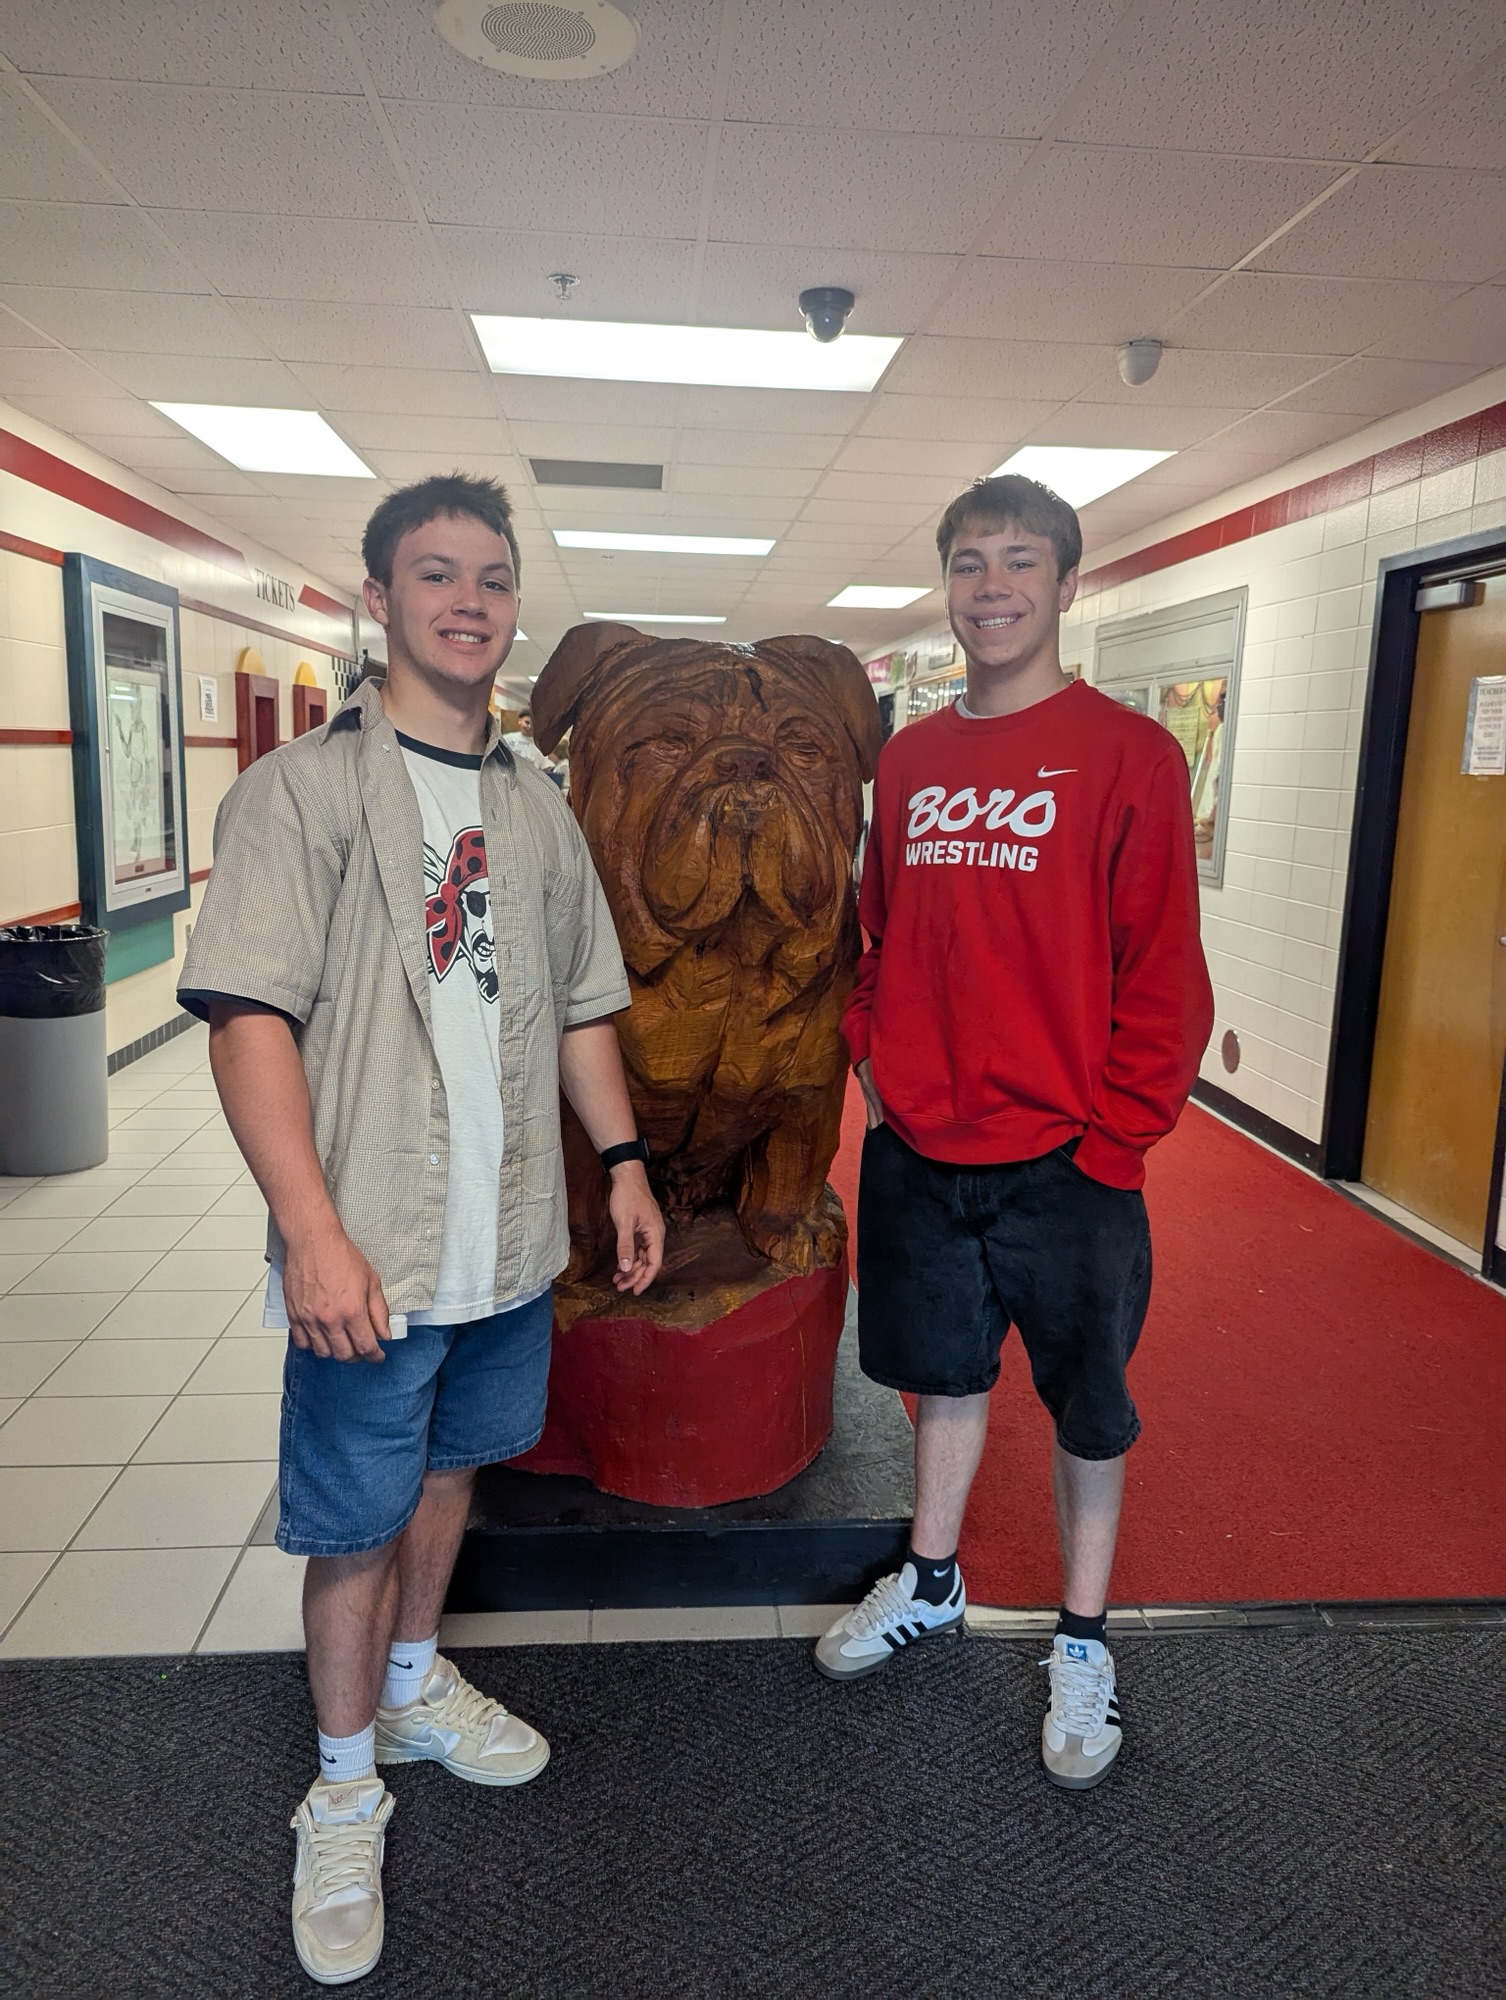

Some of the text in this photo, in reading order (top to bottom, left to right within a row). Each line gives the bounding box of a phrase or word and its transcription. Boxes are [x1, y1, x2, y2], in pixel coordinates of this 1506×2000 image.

[254, 568, 295, 613] TICKETS
[907, 786, 1057, 839] Boro
[905, 840, 1039, 873] WRESTLING
